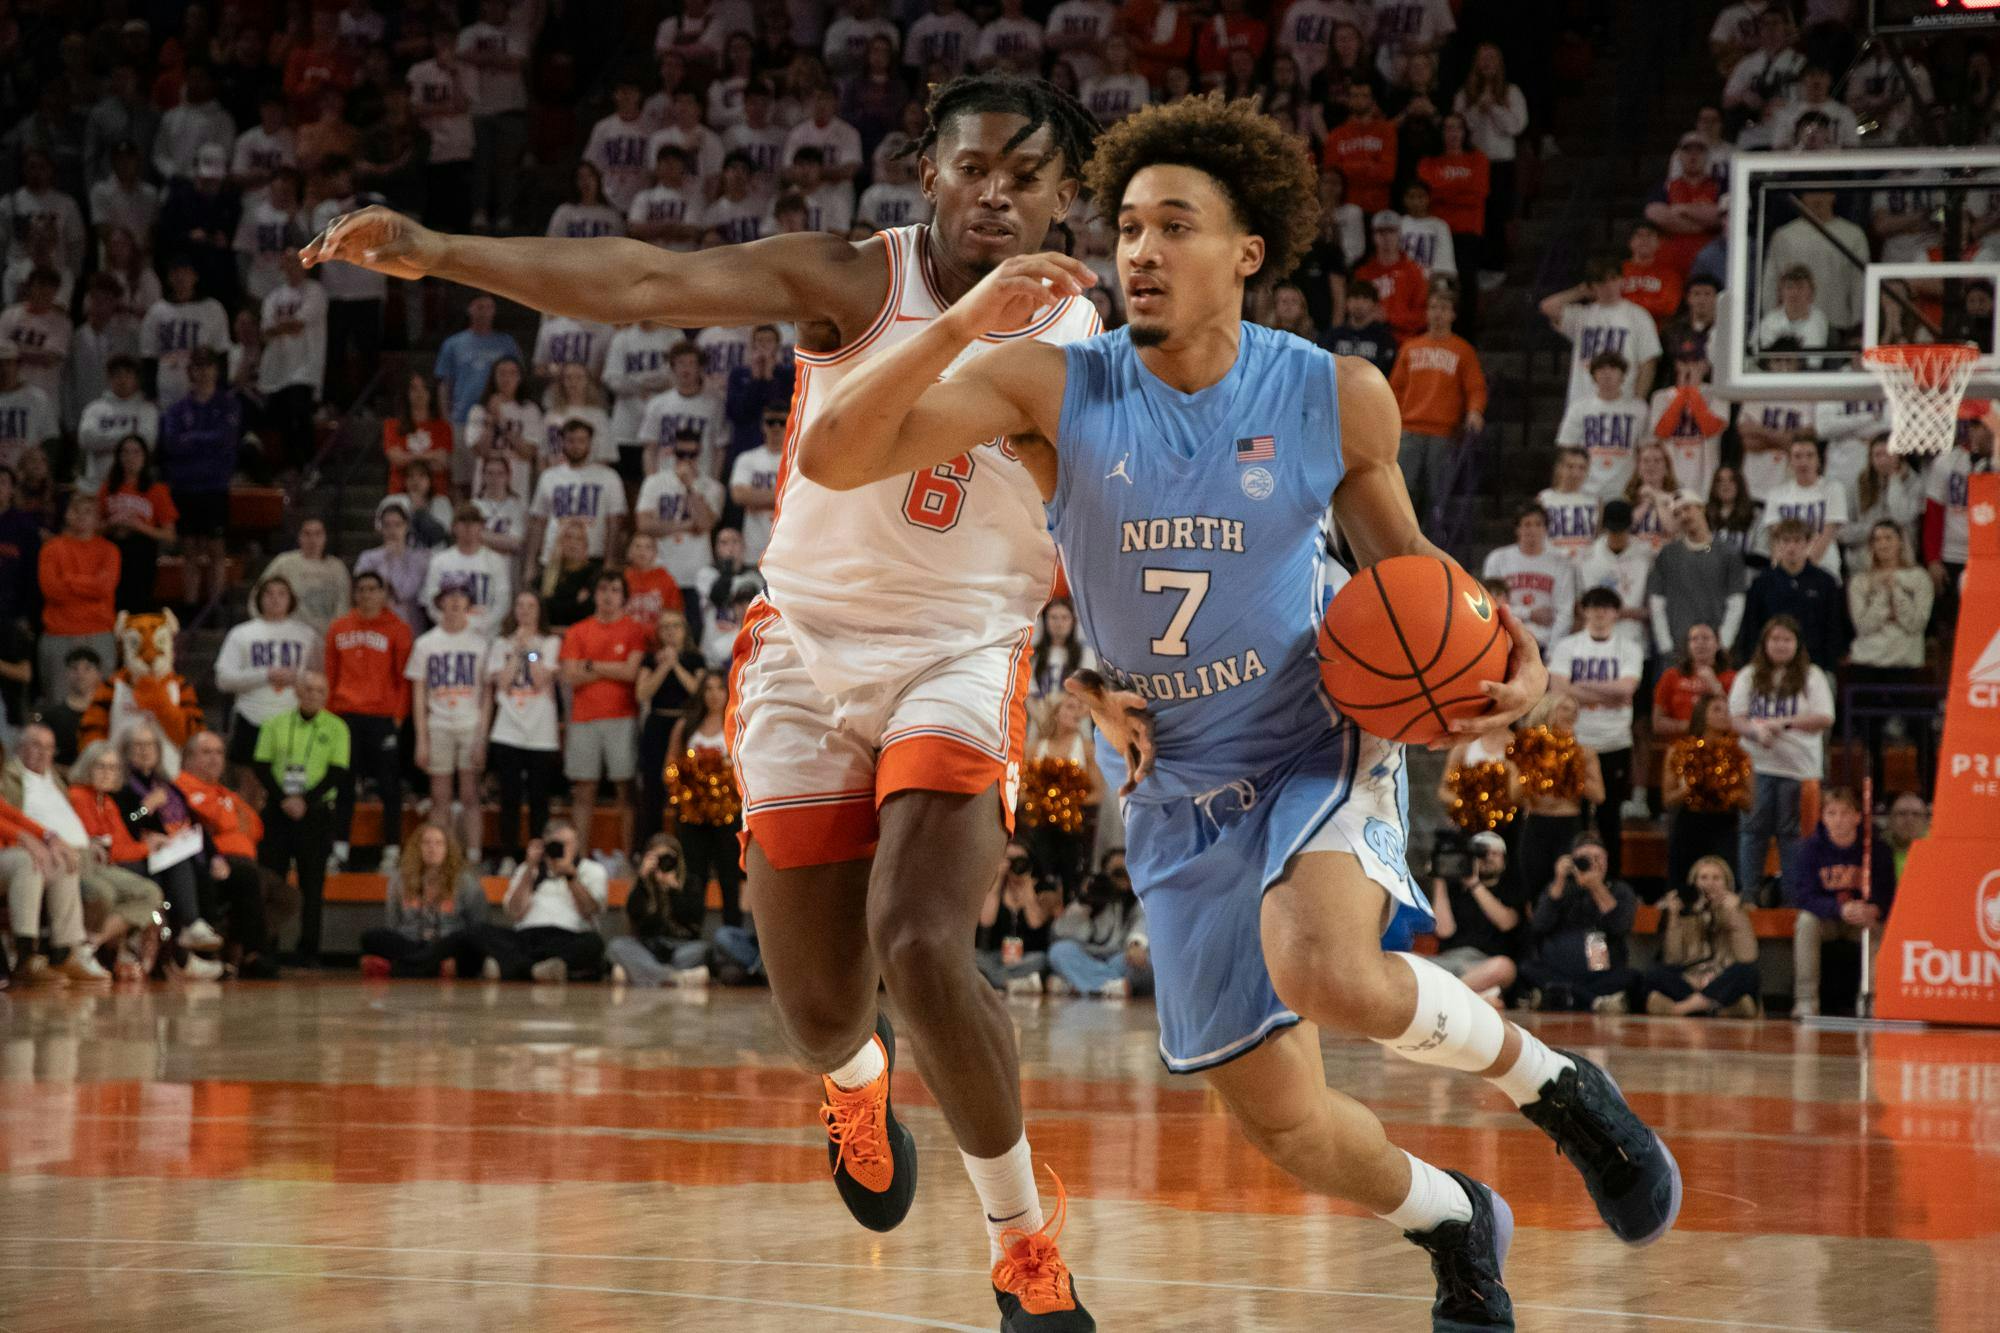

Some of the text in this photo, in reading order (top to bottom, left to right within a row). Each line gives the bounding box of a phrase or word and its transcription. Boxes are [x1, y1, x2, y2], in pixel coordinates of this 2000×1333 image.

[1402, 233, 1437, 266] EAT
[552, 333, 596, 364] BEAT
[1581, 327, 1629, 359] BEAT
[1585, 413, 1635, 448] BEAT
[553, 484, 602, 518] BEAT
[902, 452, 975, 533] 6
[1120, 514, 1245, 553] NORTH
[1549, 504, 1596, 537] BEAT
[1142, 566, 1211, 657] 7
[250, 641, 303, 668] BEAT
[428, 653, 475, 688] BEAT
[1572, 658, 1619, 683] BEAT
[1750, 696, 1799, 718] BEAT
